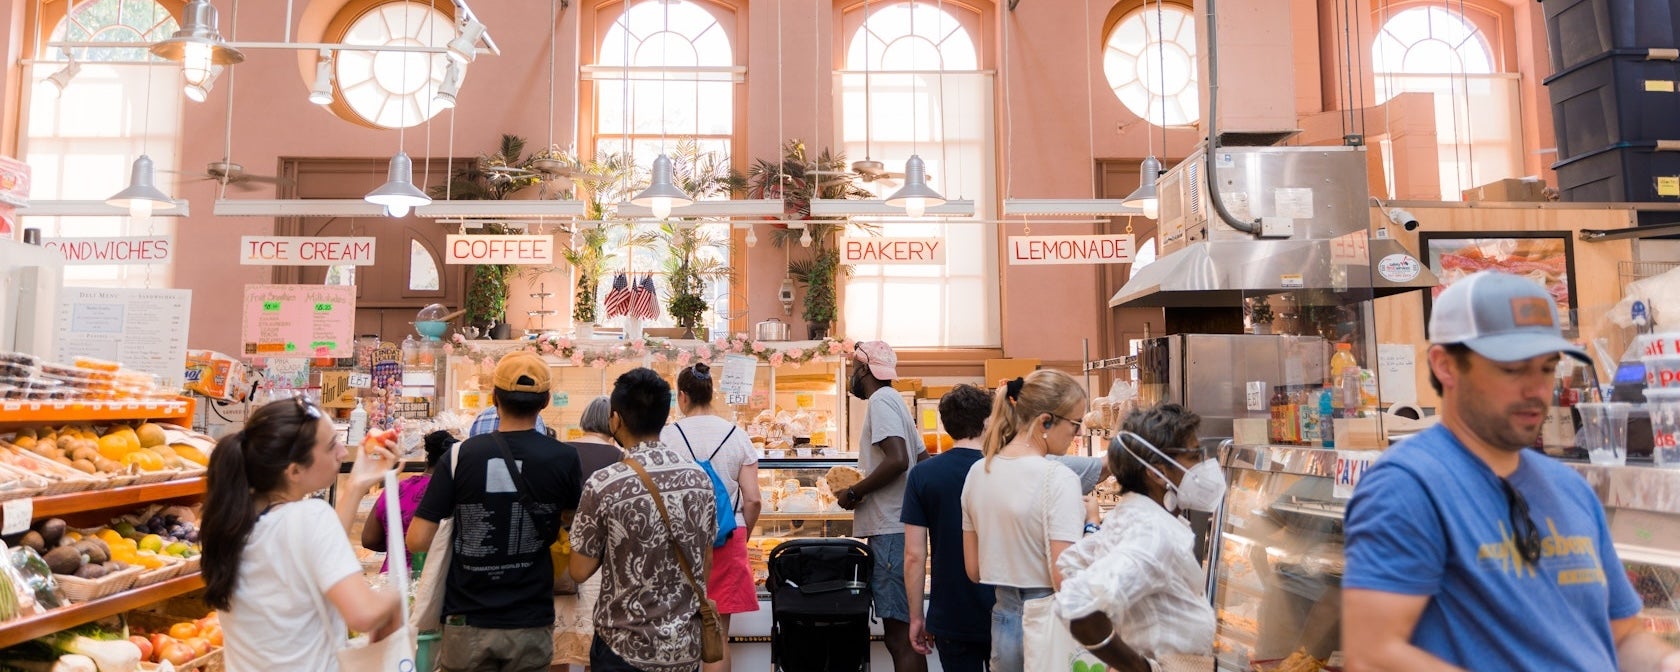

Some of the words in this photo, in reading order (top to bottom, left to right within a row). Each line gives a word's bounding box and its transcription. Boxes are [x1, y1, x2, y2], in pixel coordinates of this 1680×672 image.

[45, 240, 168, 260] ANDWICHES
[248, 240, 289, 260] ICE
[300, 240, 371, 261] CREAM
[453, 239, 547, 260] COFFEE
[847, 241, 938, 260] BAKERY
[1015, 239, 1128, 259] LEMONADE
[351, 377, 368, 386] EBT
[730, 395, 745, 404] EBT
[1336, 459, 1357, 485] PAY
